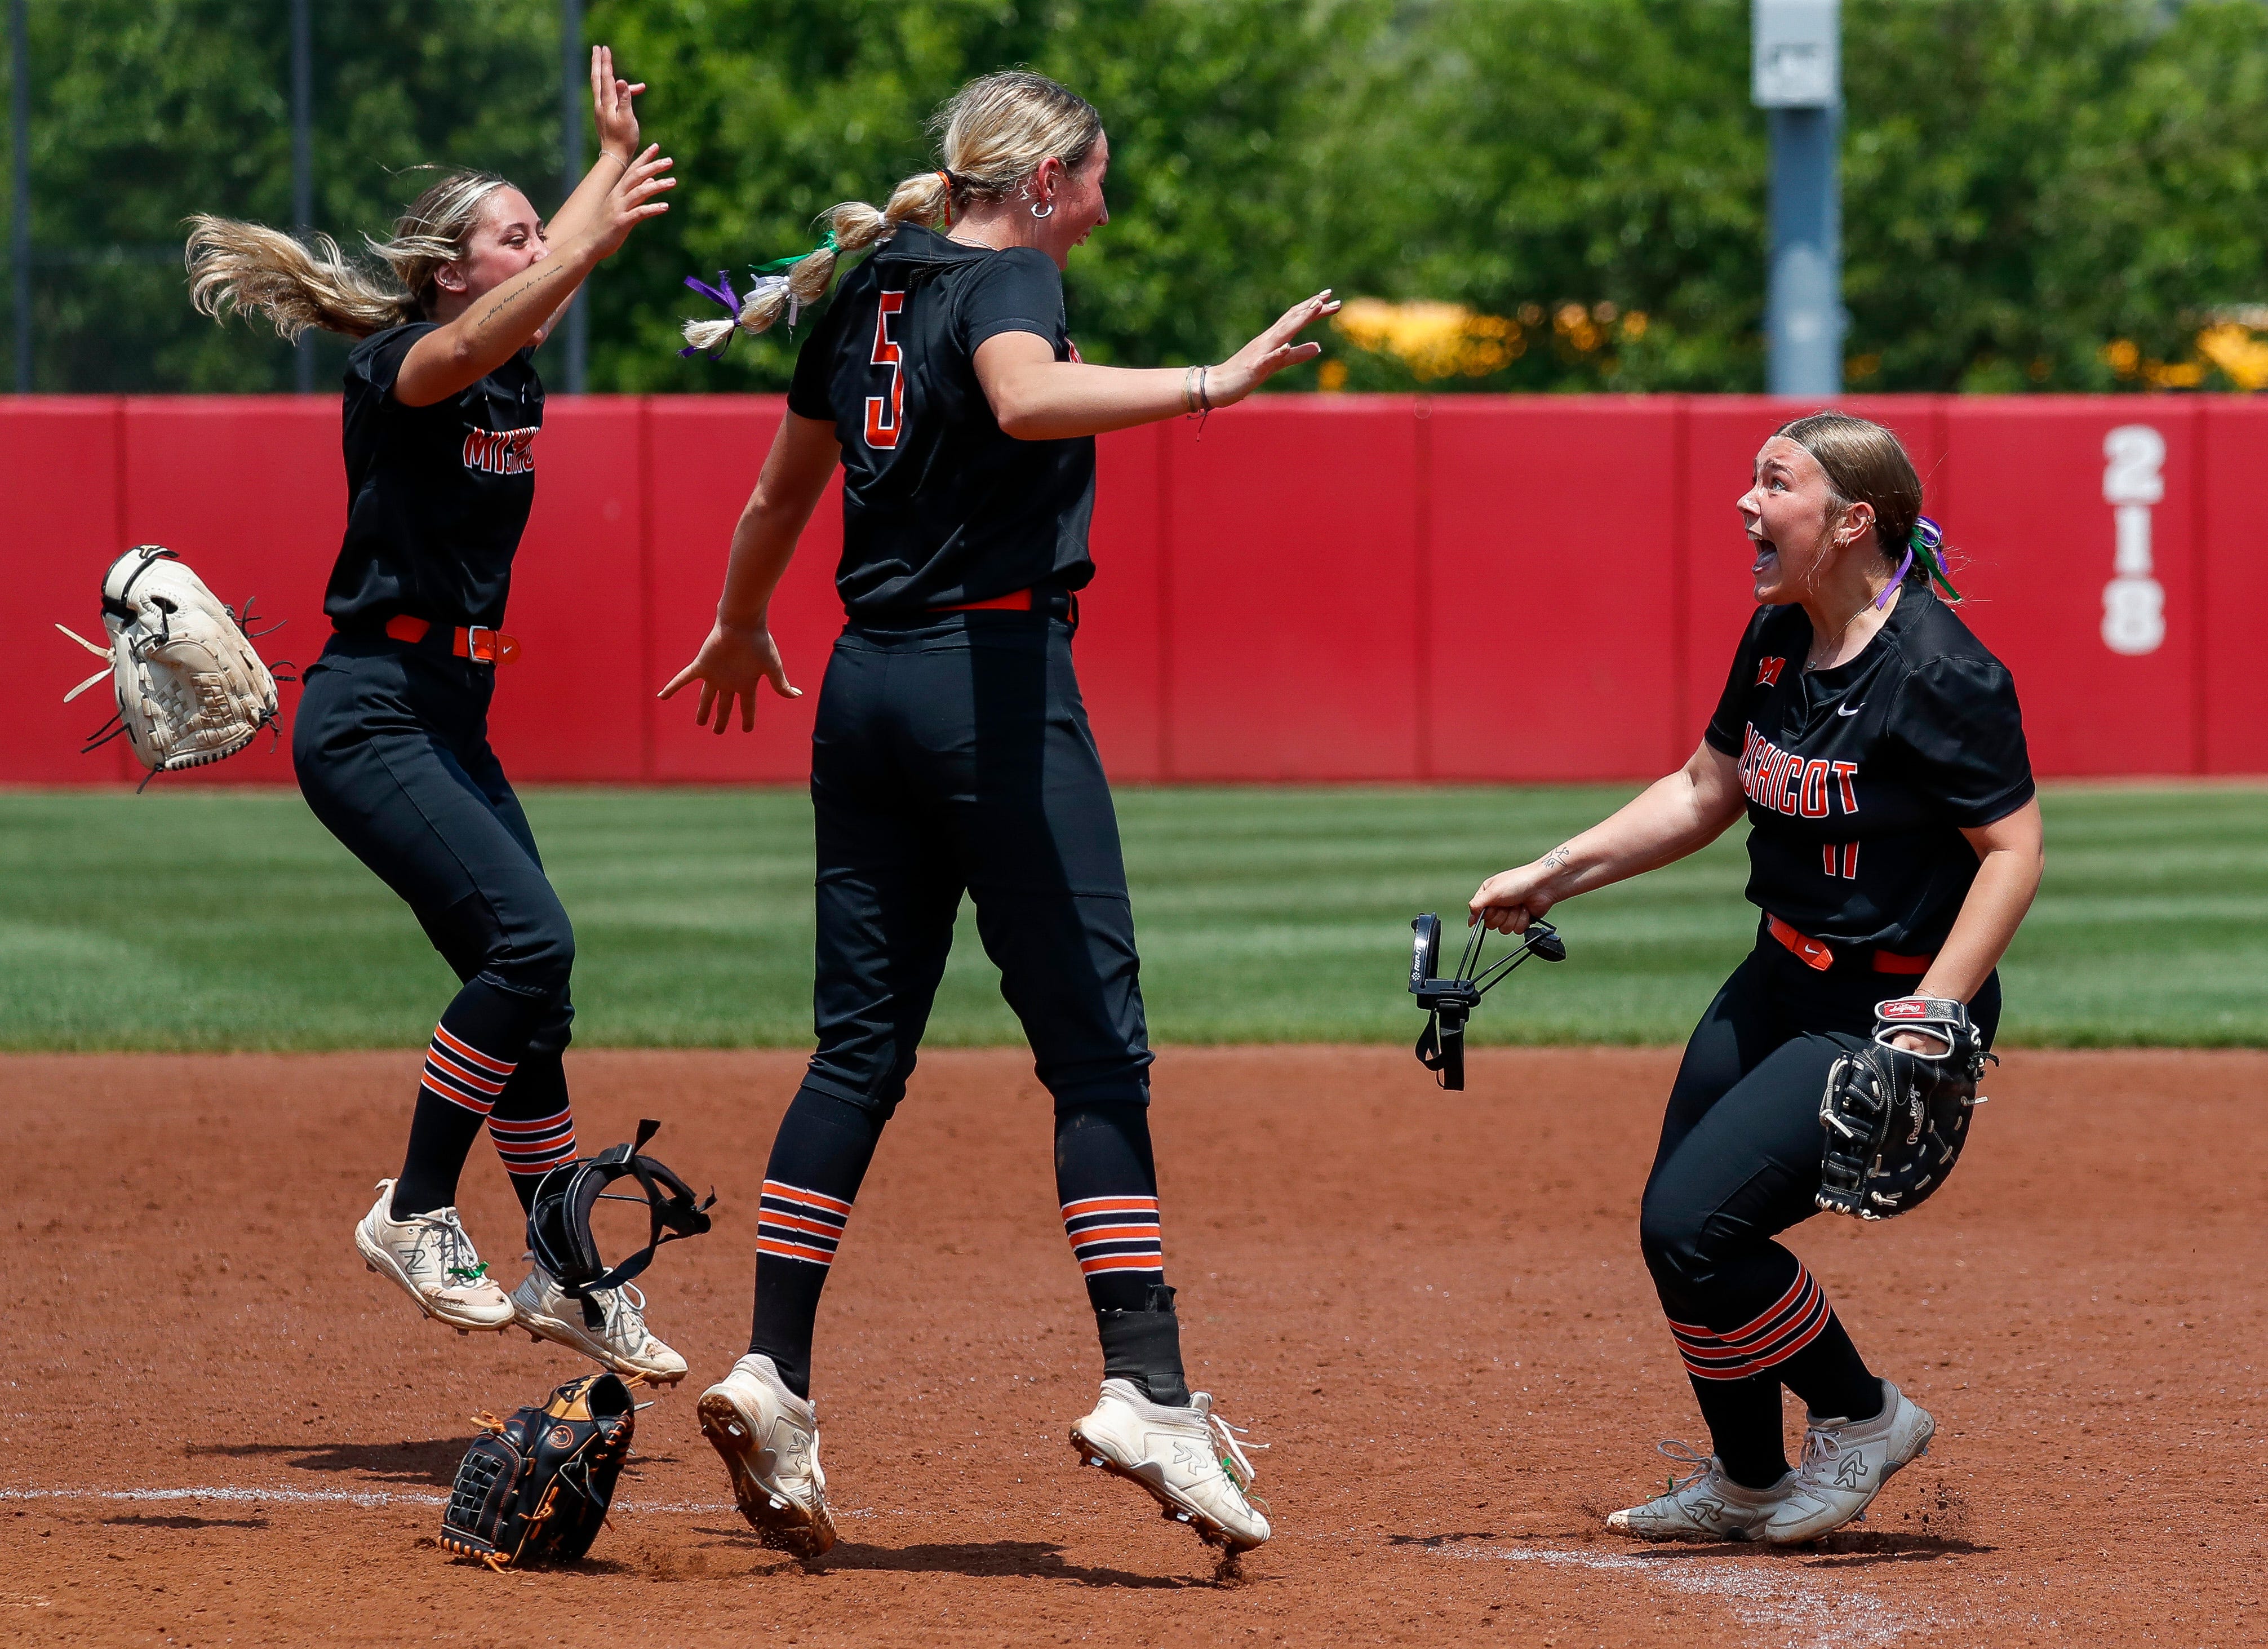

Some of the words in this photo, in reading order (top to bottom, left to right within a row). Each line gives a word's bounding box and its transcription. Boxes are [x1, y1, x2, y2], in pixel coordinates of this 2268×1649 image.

[863, 290, 905, 450] 5
[2100, 423, 2167, 657] 218
[1754, 656, 1786, 688] M
[1823, 841, 1859, 880] 11
[1907, 1084, 1924, 1145] Rawlings
